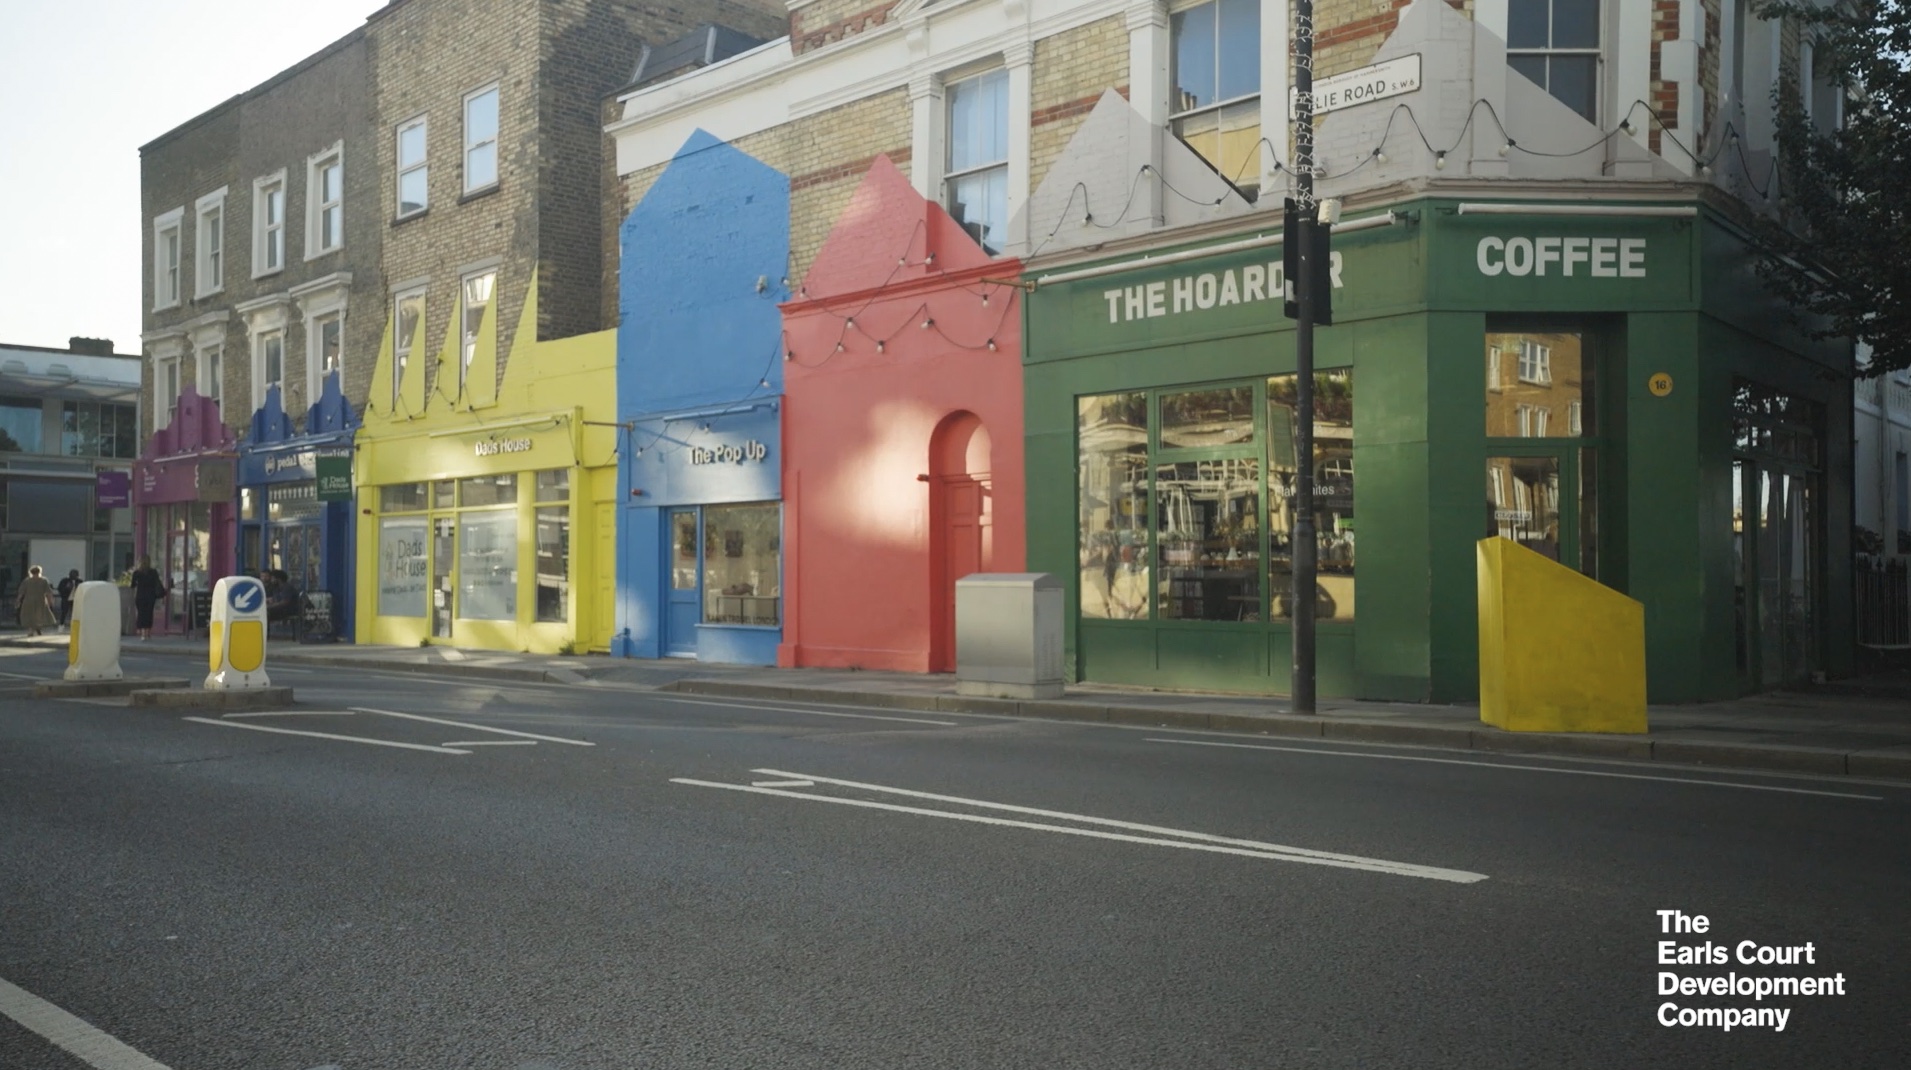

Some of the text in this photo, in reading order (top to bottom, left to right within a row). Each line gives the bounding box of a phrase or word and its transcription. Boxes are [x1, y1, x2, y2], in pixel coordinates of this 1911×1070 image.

[1344, 80, 1386, 102] ROAD
[1476, 236, 1646, 278] COFFEE
[1104, 251, 1344, 324] THE HOARDR
[1655, 380, 1667, 390] 16
[475, 438, 532, 456] Dads House
[686, 440, 766, 465] The Pop Up
[398, 539, 423, 559] Dads
[395, 559, 426, 579] House
